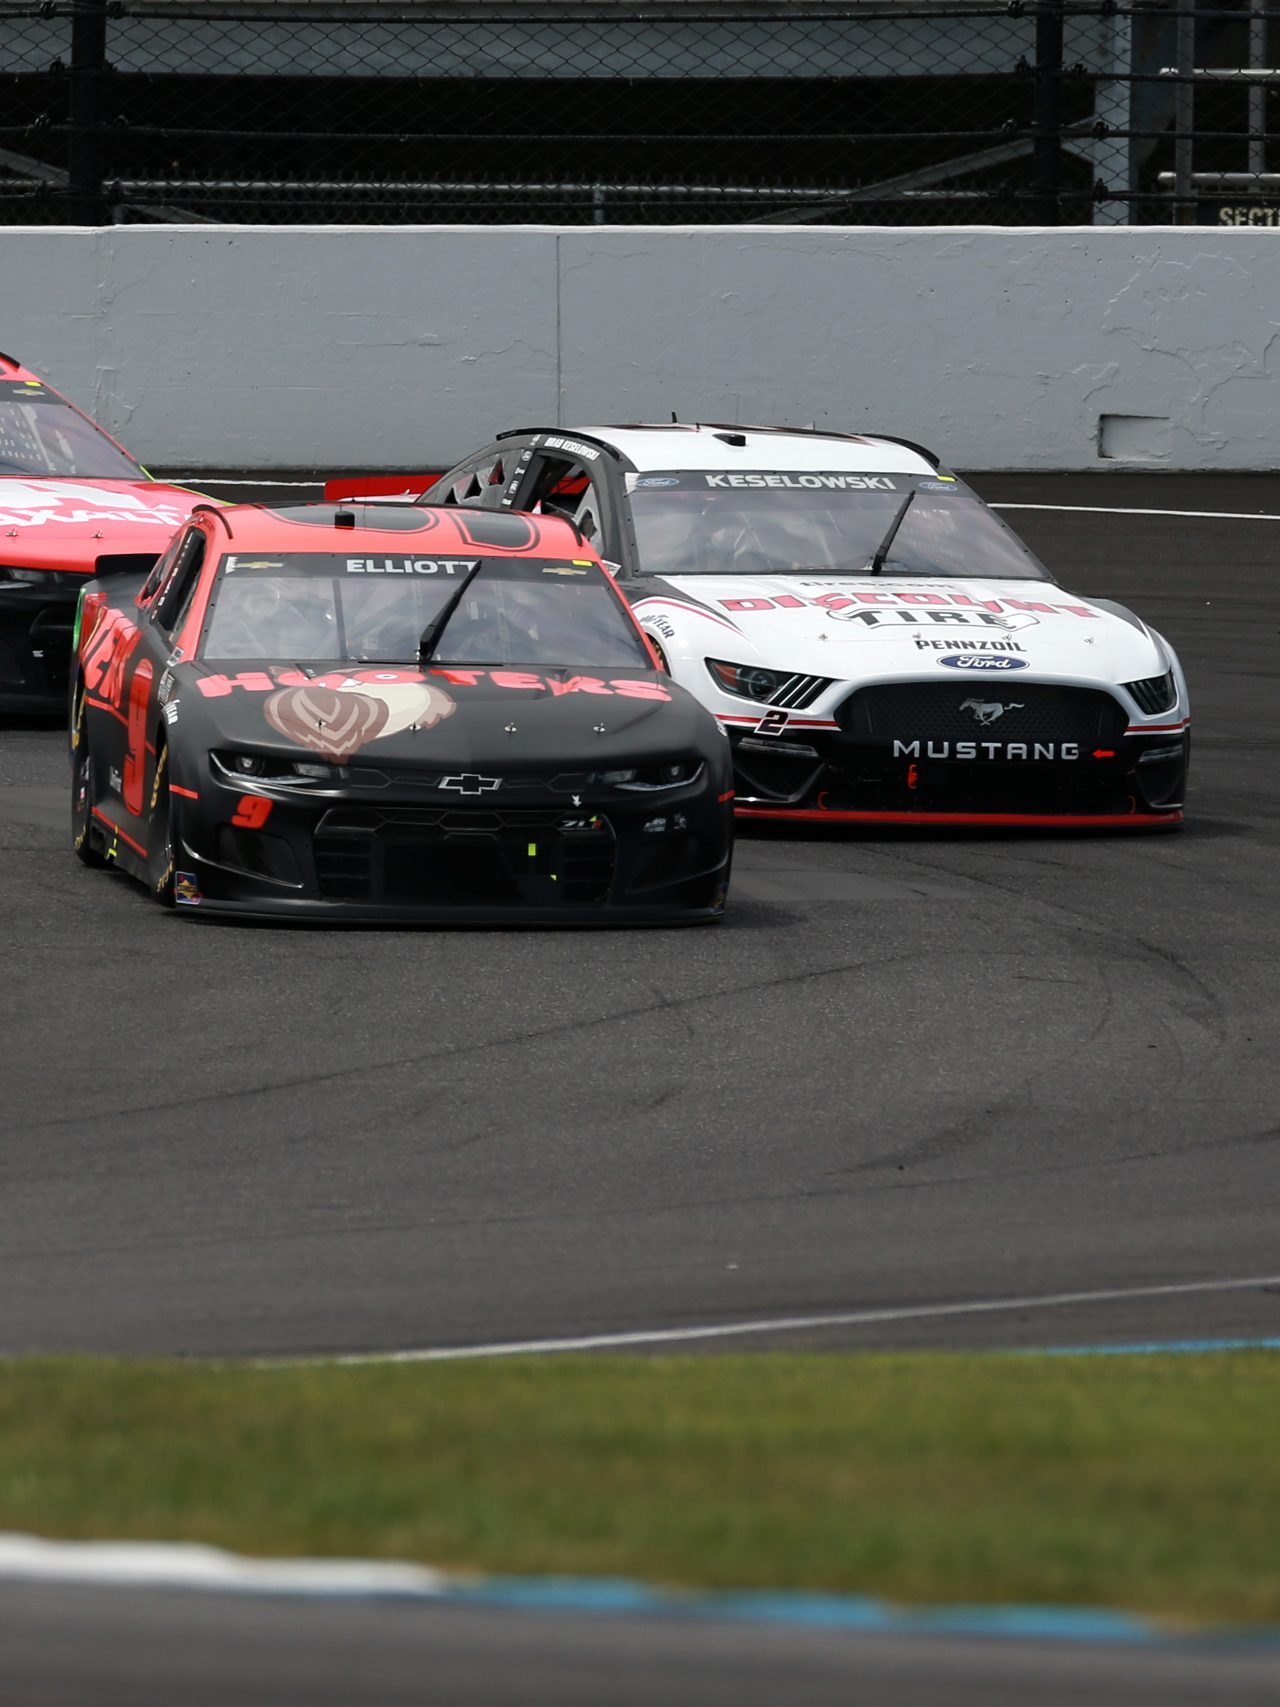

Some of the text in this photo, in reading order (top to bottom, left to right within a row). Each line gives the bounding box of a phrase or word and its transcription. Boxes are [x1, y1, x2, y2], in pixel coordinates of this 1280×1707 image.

[1219, 207, 1280, 227] SECT
[704, 474, 897, 490] KESELOWSKI
[346, 559, 478, 576] ELLIOTT
[719, 591, 1102, 620] DISCOUNT
[849, 610, 1017, 631] TIRE
[915, 639, 1029, 653] PENNZOIL
[194, 667, 673, 702] HOOTERS
[754, 710, 790, 737] 2
[123, 657, 154, 817] 9
[892, 739, 1080, 760] MUSTANG
[231, 794, 274, 830] 9
